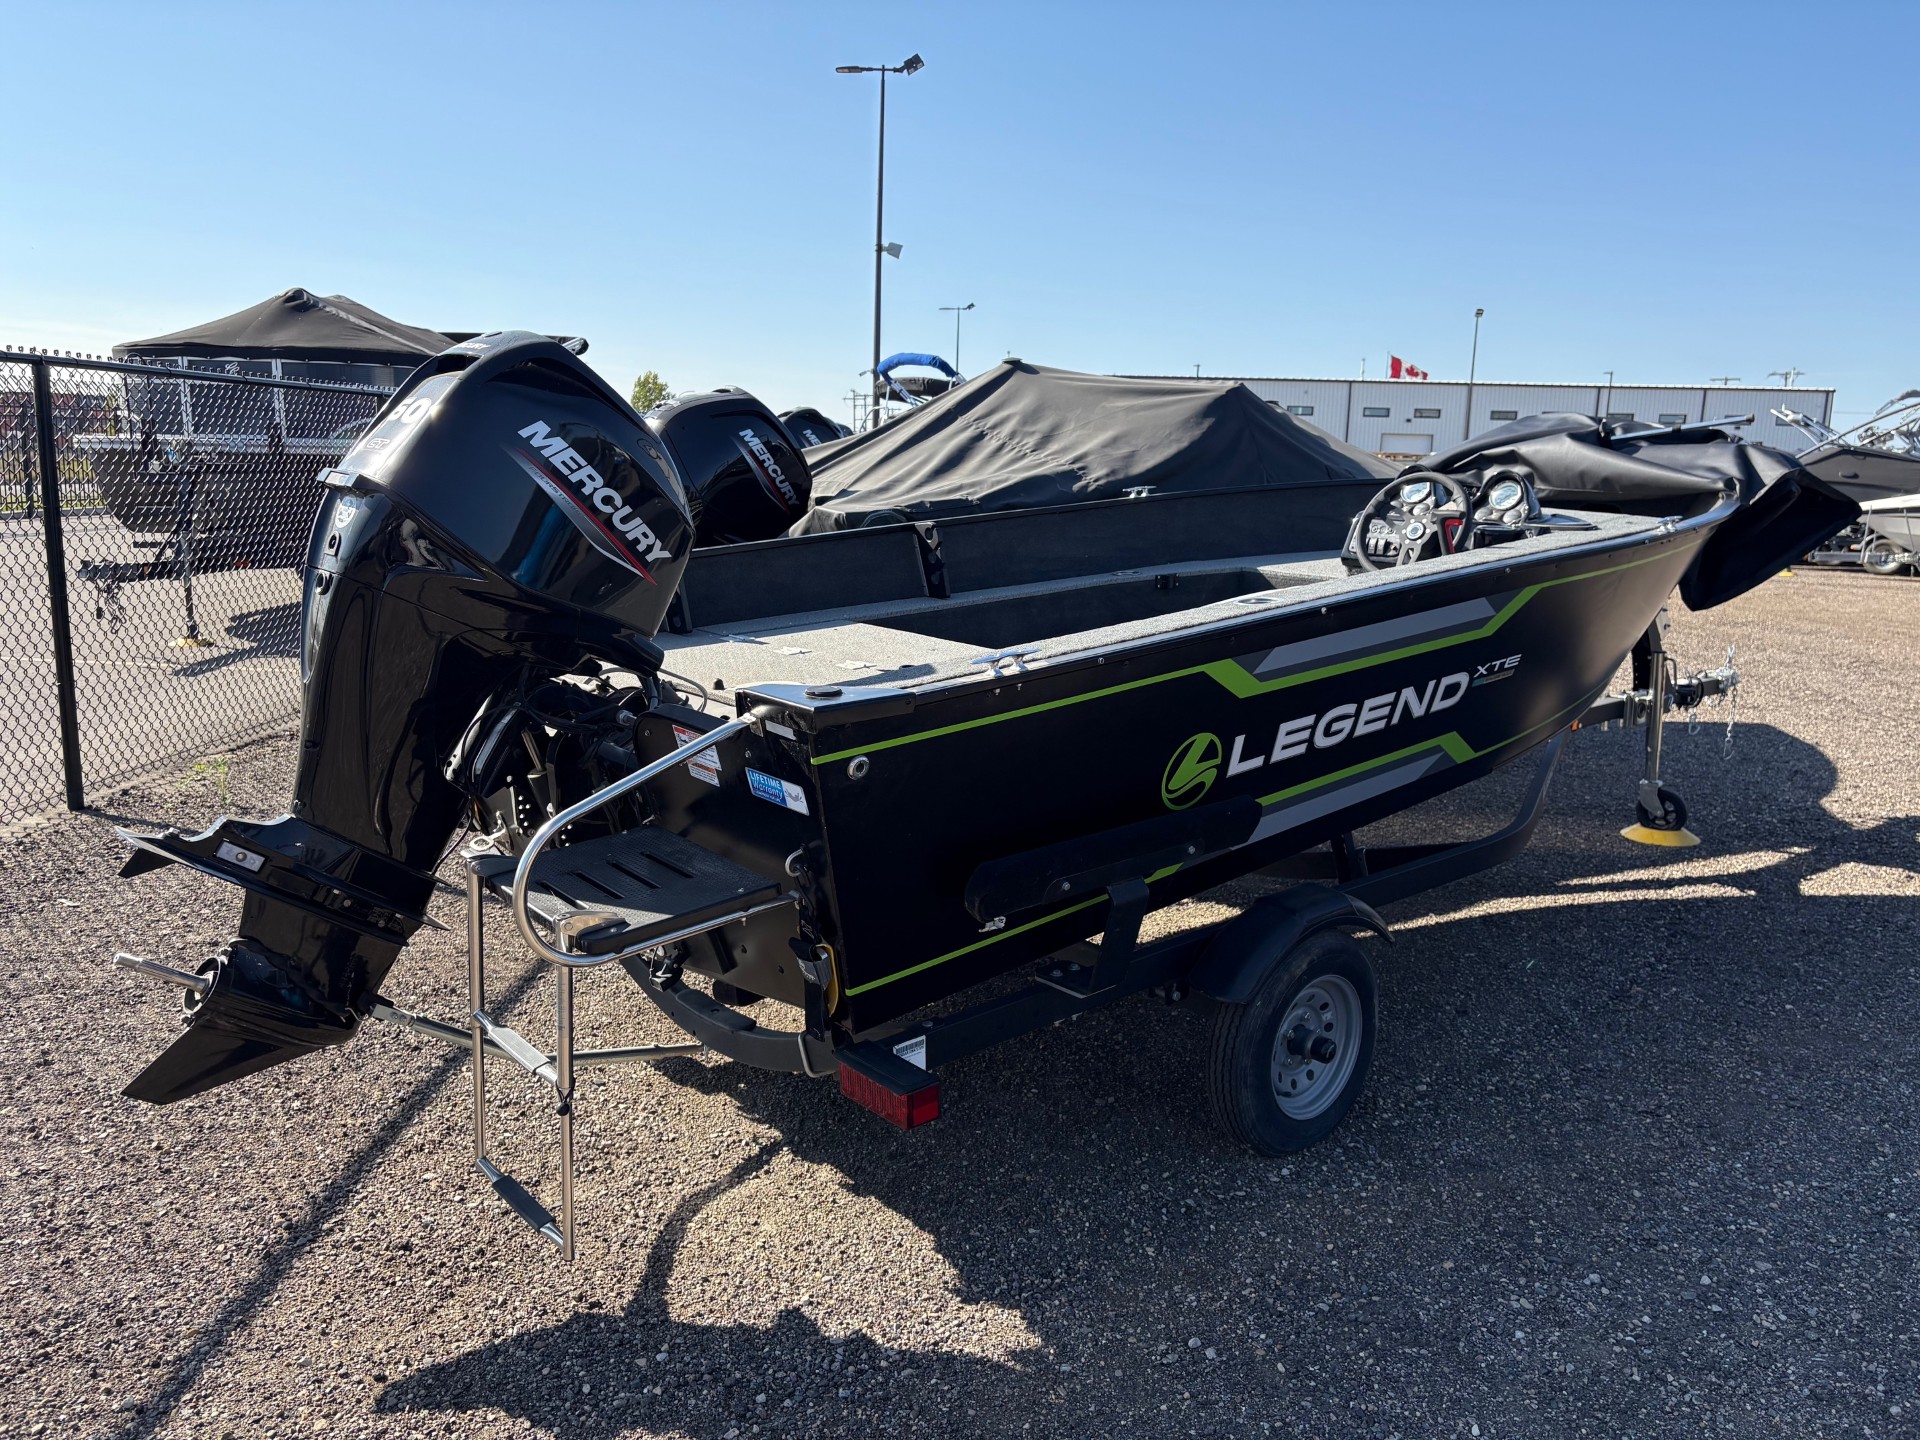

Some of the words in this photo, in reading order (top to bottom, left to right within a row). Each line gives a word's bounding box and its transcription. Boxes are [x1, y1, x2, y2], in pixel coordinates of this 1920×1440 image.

[387, 397, 431, 423] 60
[517, 420, 672, 563] MERCURY
[738, 428, 800, 505] MERCURY
[1226, 671, 1470, 778] LEGEND
[1473, 654, 1522, 678] XTE
[749, 770, 782, 790] LIFETIME
[752, 779, 783, 800] Warranty
